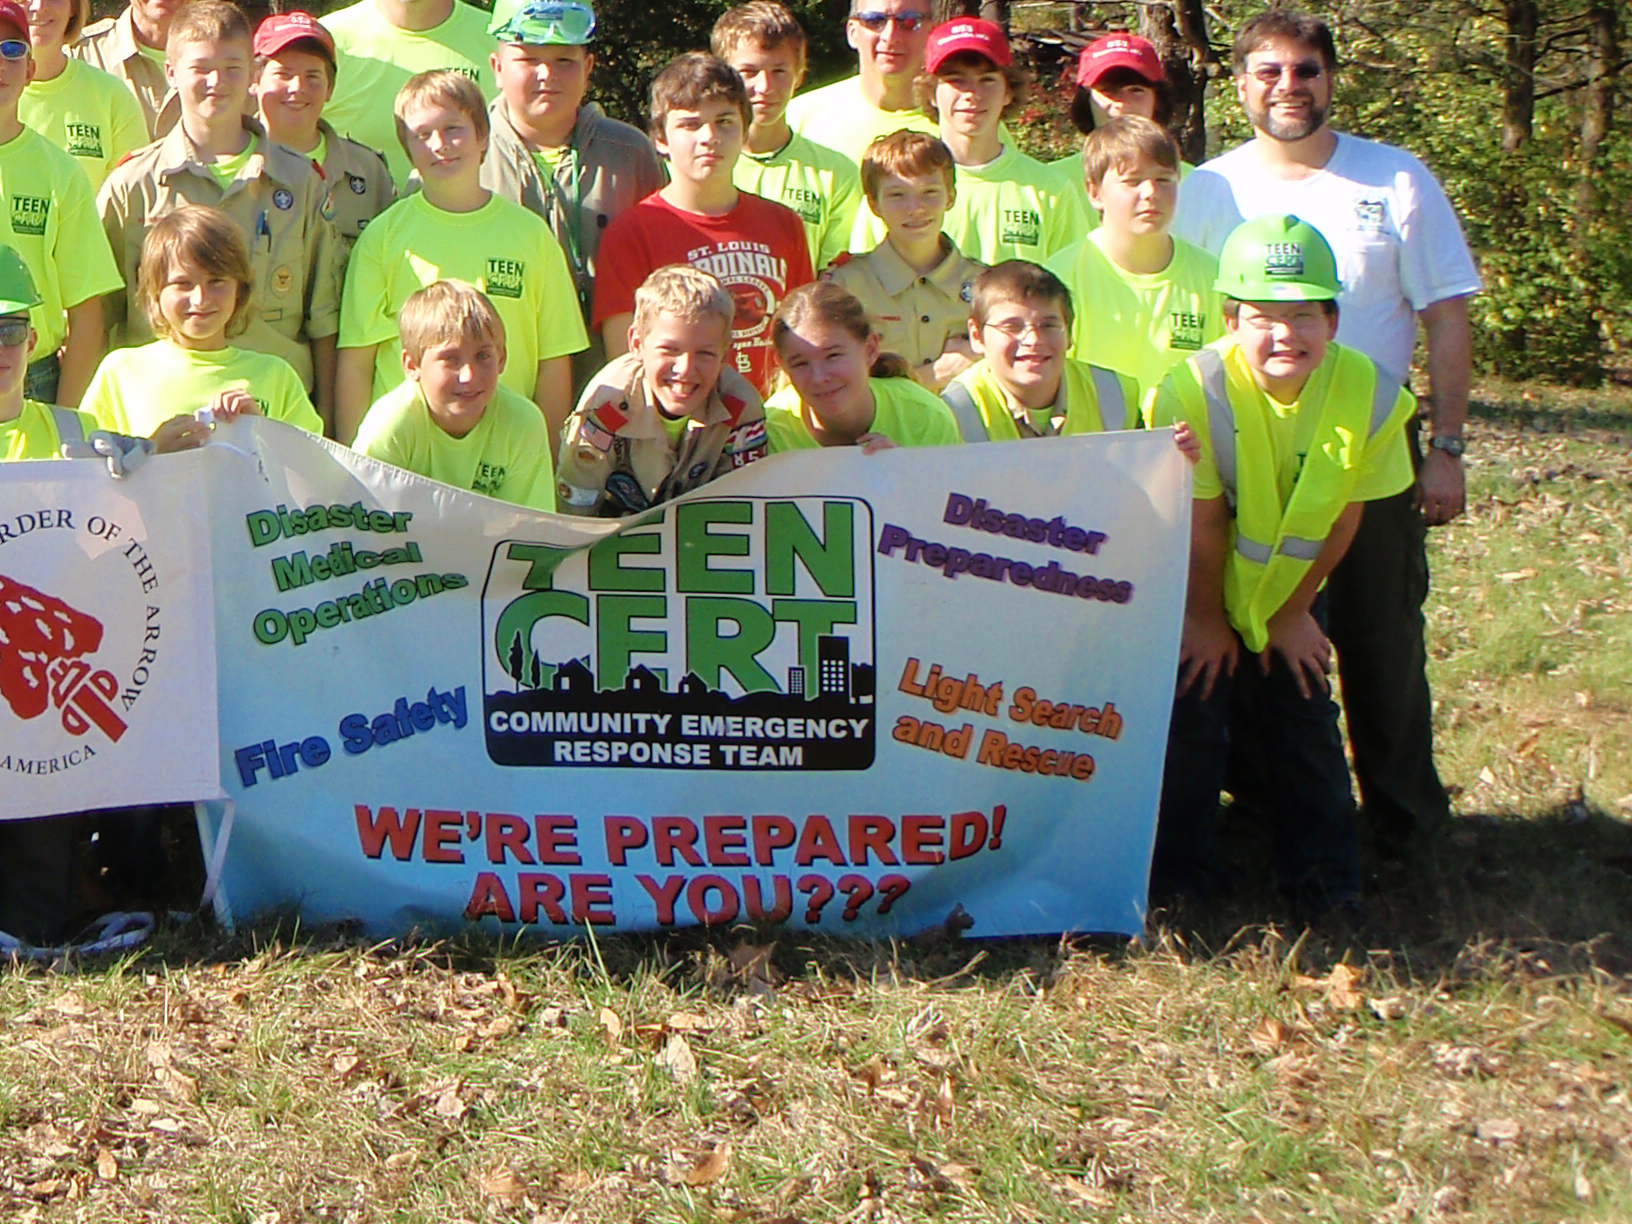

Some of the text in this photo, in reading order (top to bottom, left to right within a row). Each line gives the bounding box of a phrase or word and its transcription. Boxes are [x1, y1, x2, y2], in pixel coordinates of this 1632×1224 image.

[67, 124, 100, 140] TEEN
[13, 196, 51, 215] TEEN
[788, 188, 822, 205] TEEN
[1004, 210, 1039, 224] TEEN
[488, 259, 525, 277] TEEN
[717, 240, 771, 255] LOUIS
[1267, 243, 1300, 256] TEEN
[692, 252, 788, 292] RDINALS
[734, 450, 761, 467] 85
[87, 515, 123, 542] OF
[246, 501, 413, 547] Disaster
[943, 492, 1110, 555] Disaster
[122, 538, 159, 595] THE
[271, 541, 423, 592] Medical
[506, 500, 856, 598] TEEN
[877, 523, 1135, 604] Preparedness
[253, 572, 469, 646] Operations
[120, 604, 161, 712] ARROW
[495, 589, 857, 702] CERT
[898, 657, 1125, 741] Light Search
[234, 685, 468, 789] Fire Safety
[489, 710, 870, 740] COMMUNITY EMERGENCY
[892, 714, 1097, 782] and Rescue
[0, 743, 97, 776] AMERICA
[553, 741, 803, 767] RESPONSE TEAM
[354, 804, 1008, 867] WE'RE PREPARED!
[464, 872, 912, 927] ARE YOU???
